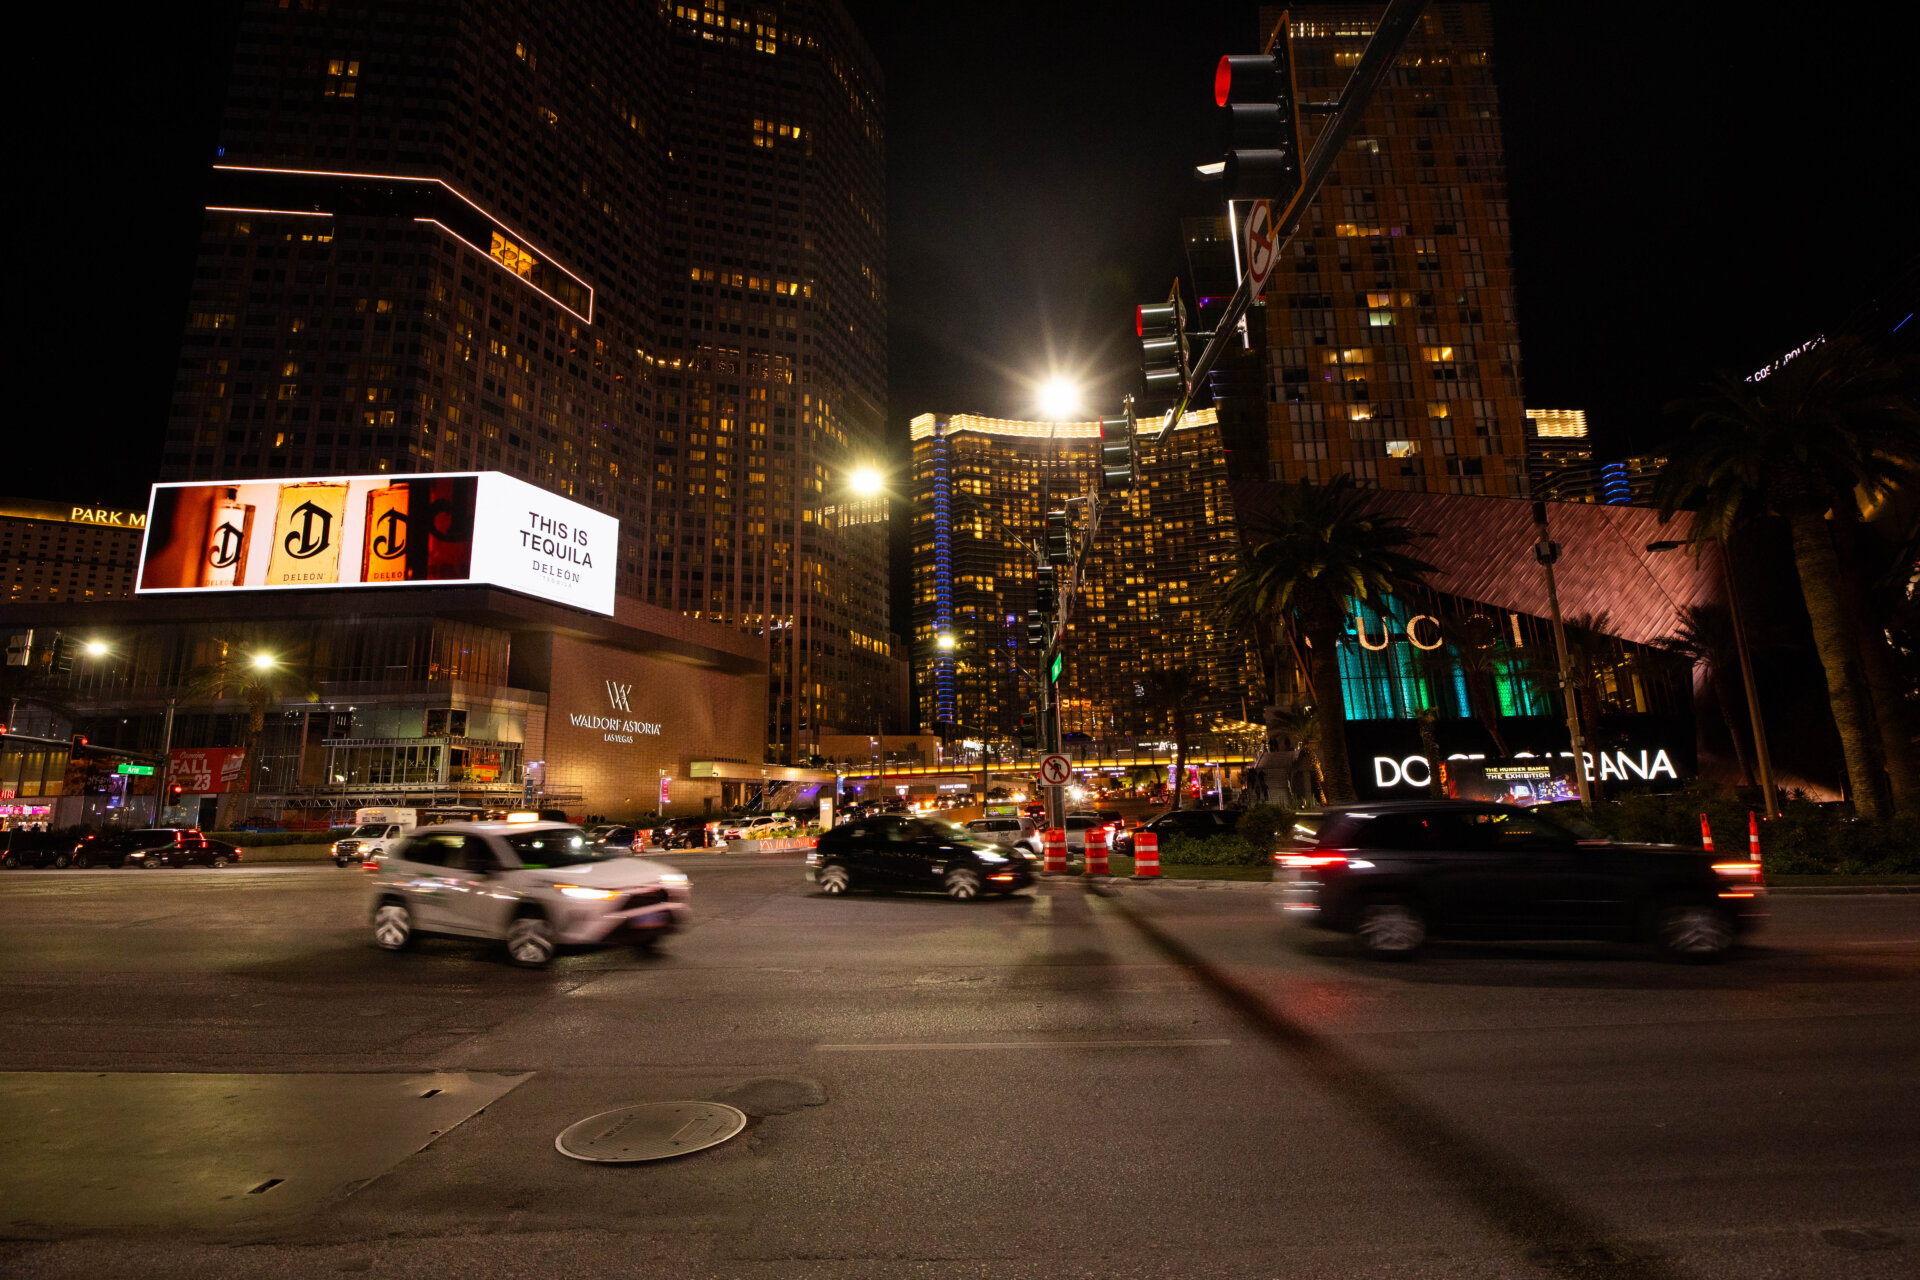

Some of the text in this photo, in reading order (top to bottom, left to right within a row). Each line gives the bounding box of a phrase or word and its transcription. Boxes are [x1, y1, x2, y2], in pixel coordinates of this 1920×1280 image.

[71, 507, 123, 525] PARK
[528, 511, 588, 547] THIS IS
[520, 529, 593, 569] TEQUILA
[570, 712, 661, 736] WALDORF ASTORIA
[604, 733, 634, 744] LAS VEGAS
[169, 759, 212, 775] FALL
